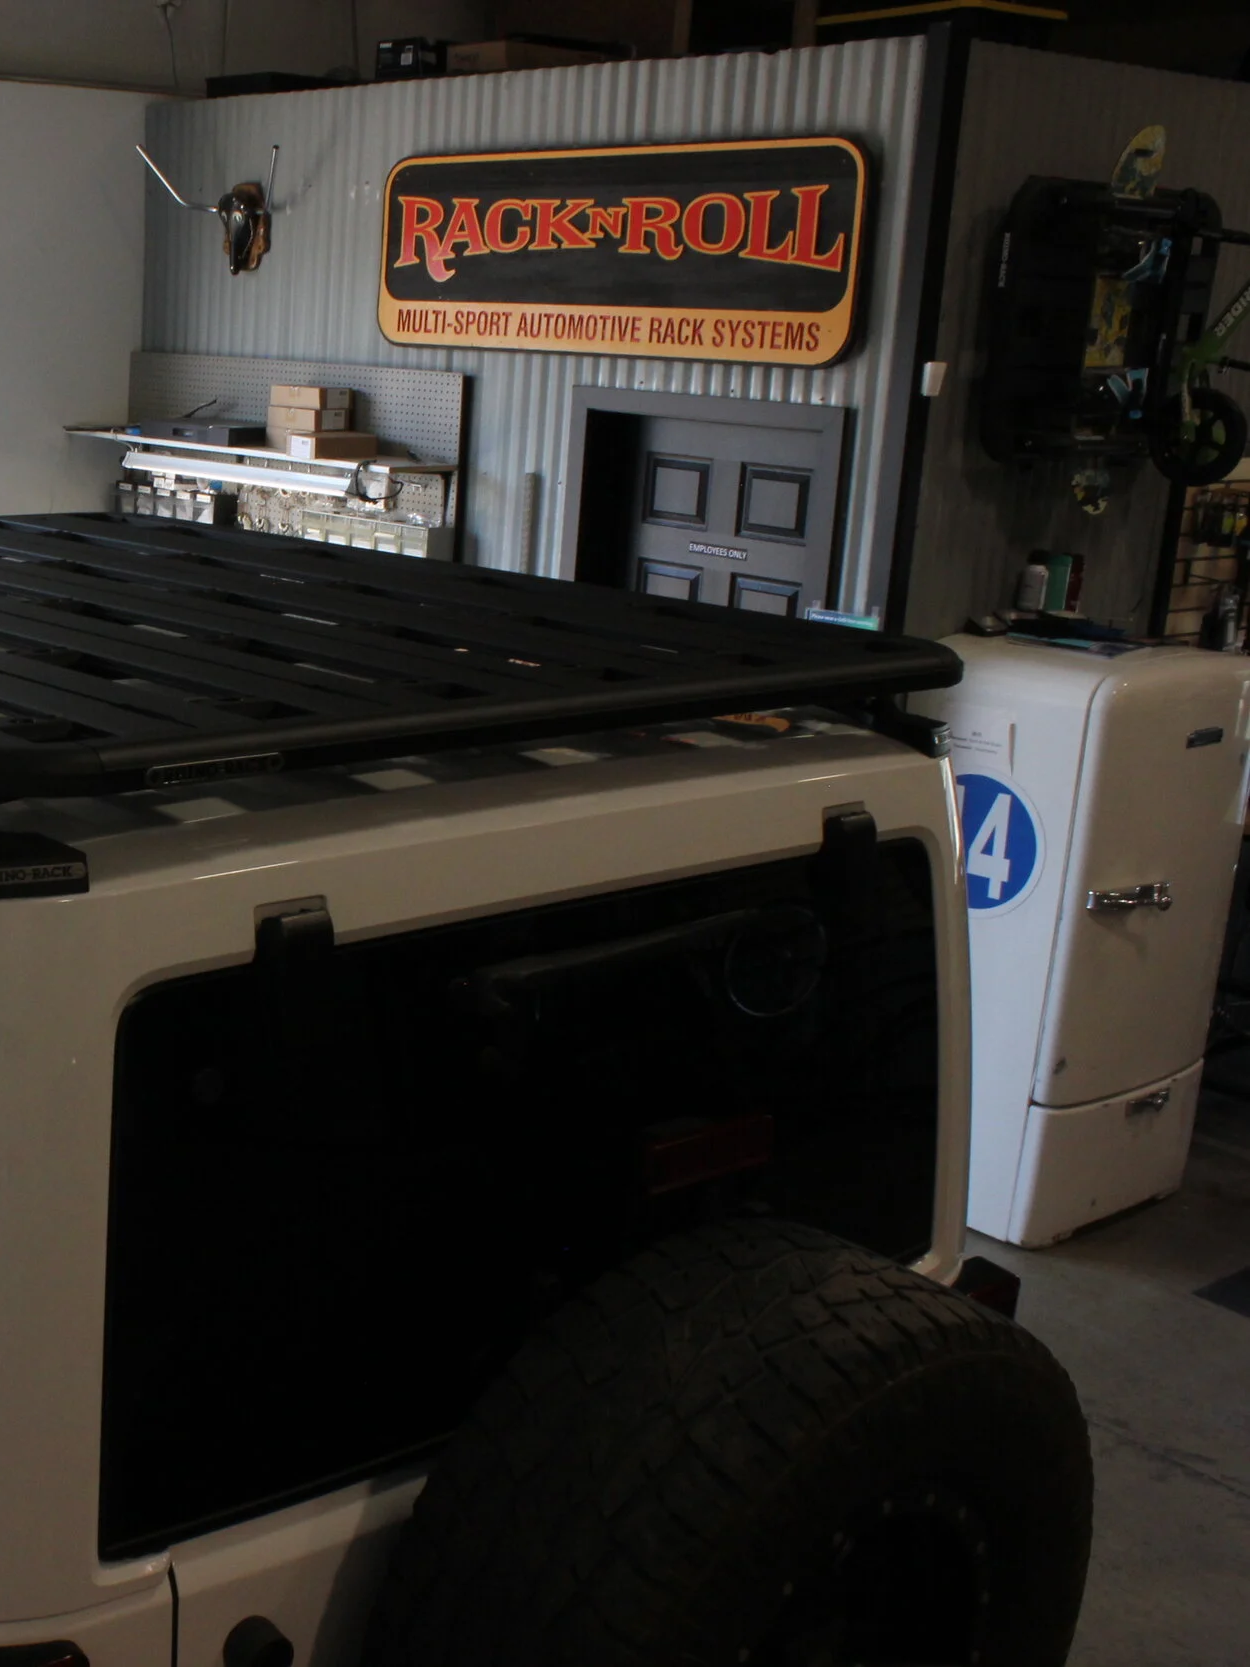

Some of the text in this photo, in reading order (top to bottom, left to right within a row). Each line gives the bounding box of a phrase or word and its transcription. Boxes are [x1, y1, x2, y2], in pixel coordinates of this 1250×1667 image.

[394, 196, 596, 282] RACK
[618, 184, 844, 272] ROLL
[397, 308, 821, 351] MULTI-SPORT AUTOMOTIVE RACK SYSTEMS
[689, 543, 747, 560] EMPLOYEES ONLY
[956, 784, 1012, 900] 4
